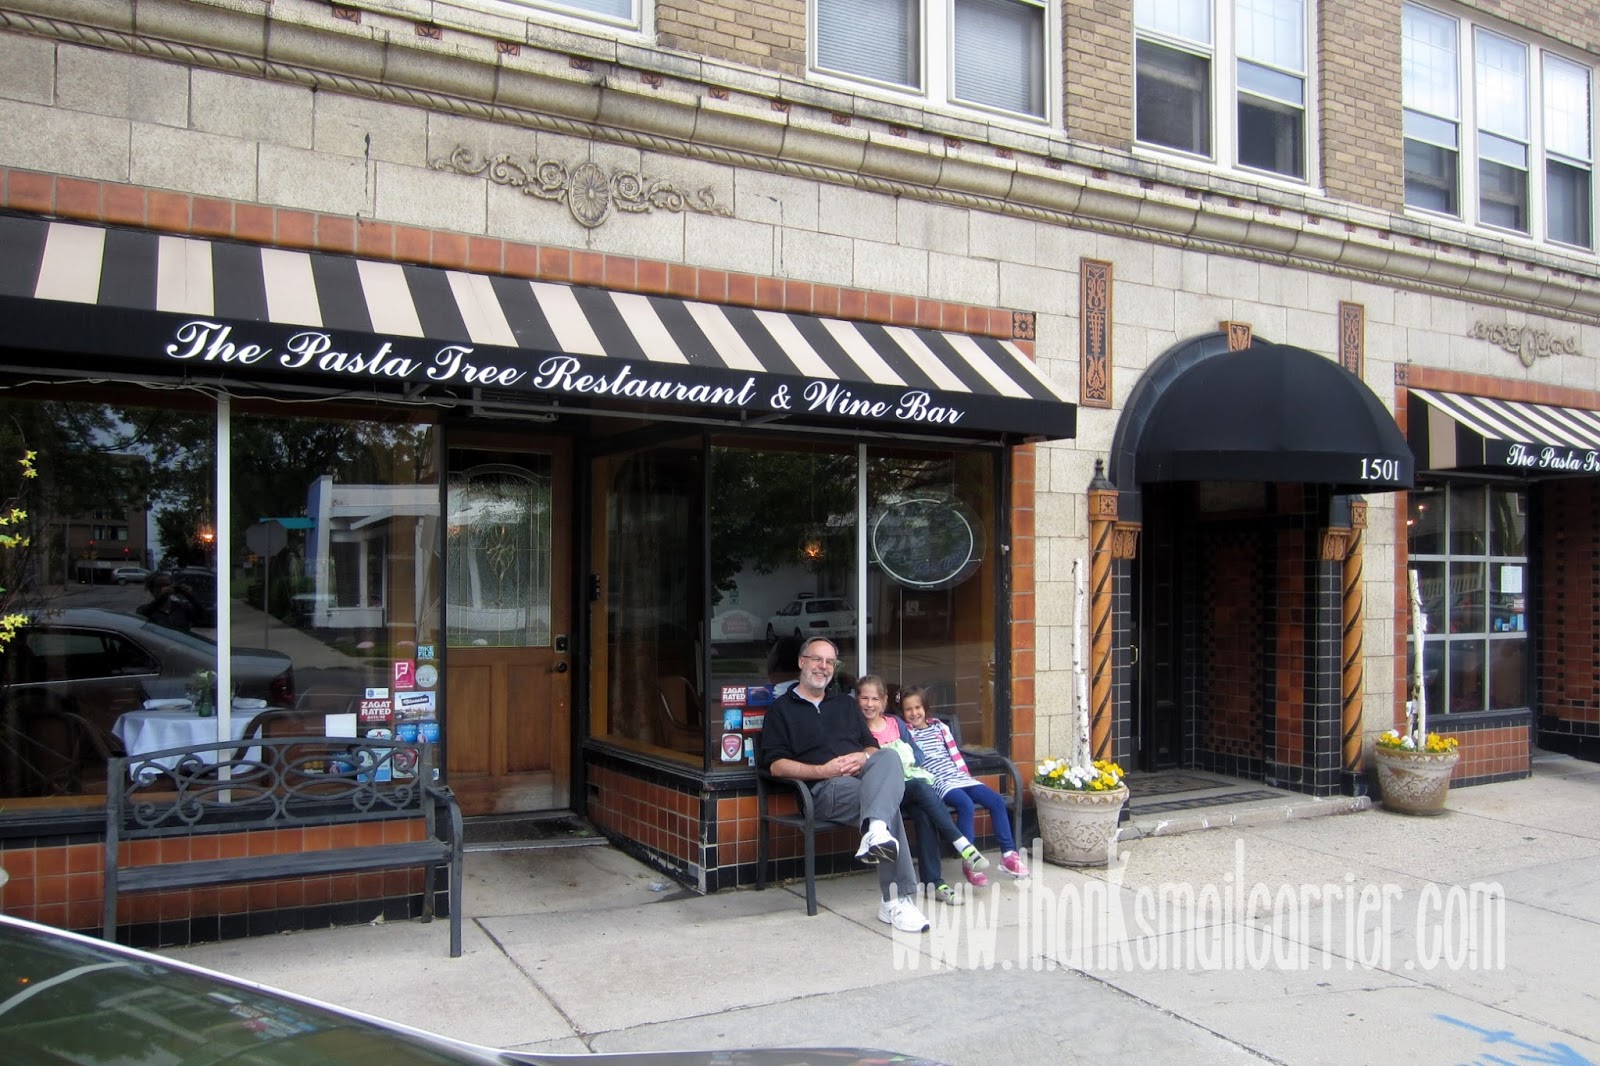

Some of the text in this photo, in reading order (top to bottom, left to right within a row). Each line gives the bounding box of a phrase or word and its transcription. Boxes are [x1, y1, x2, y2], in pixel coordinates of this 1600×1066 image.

[166, 320, 966, 426] The Pasta Tree Restaurant & Wine Bar
[1506, 443, 1538, 467] The
[1539, 446, 1582, 470] Pasta
[1360, 458, 1399, 481] 1501
[361, 701, 391, 709] ZAGAT
